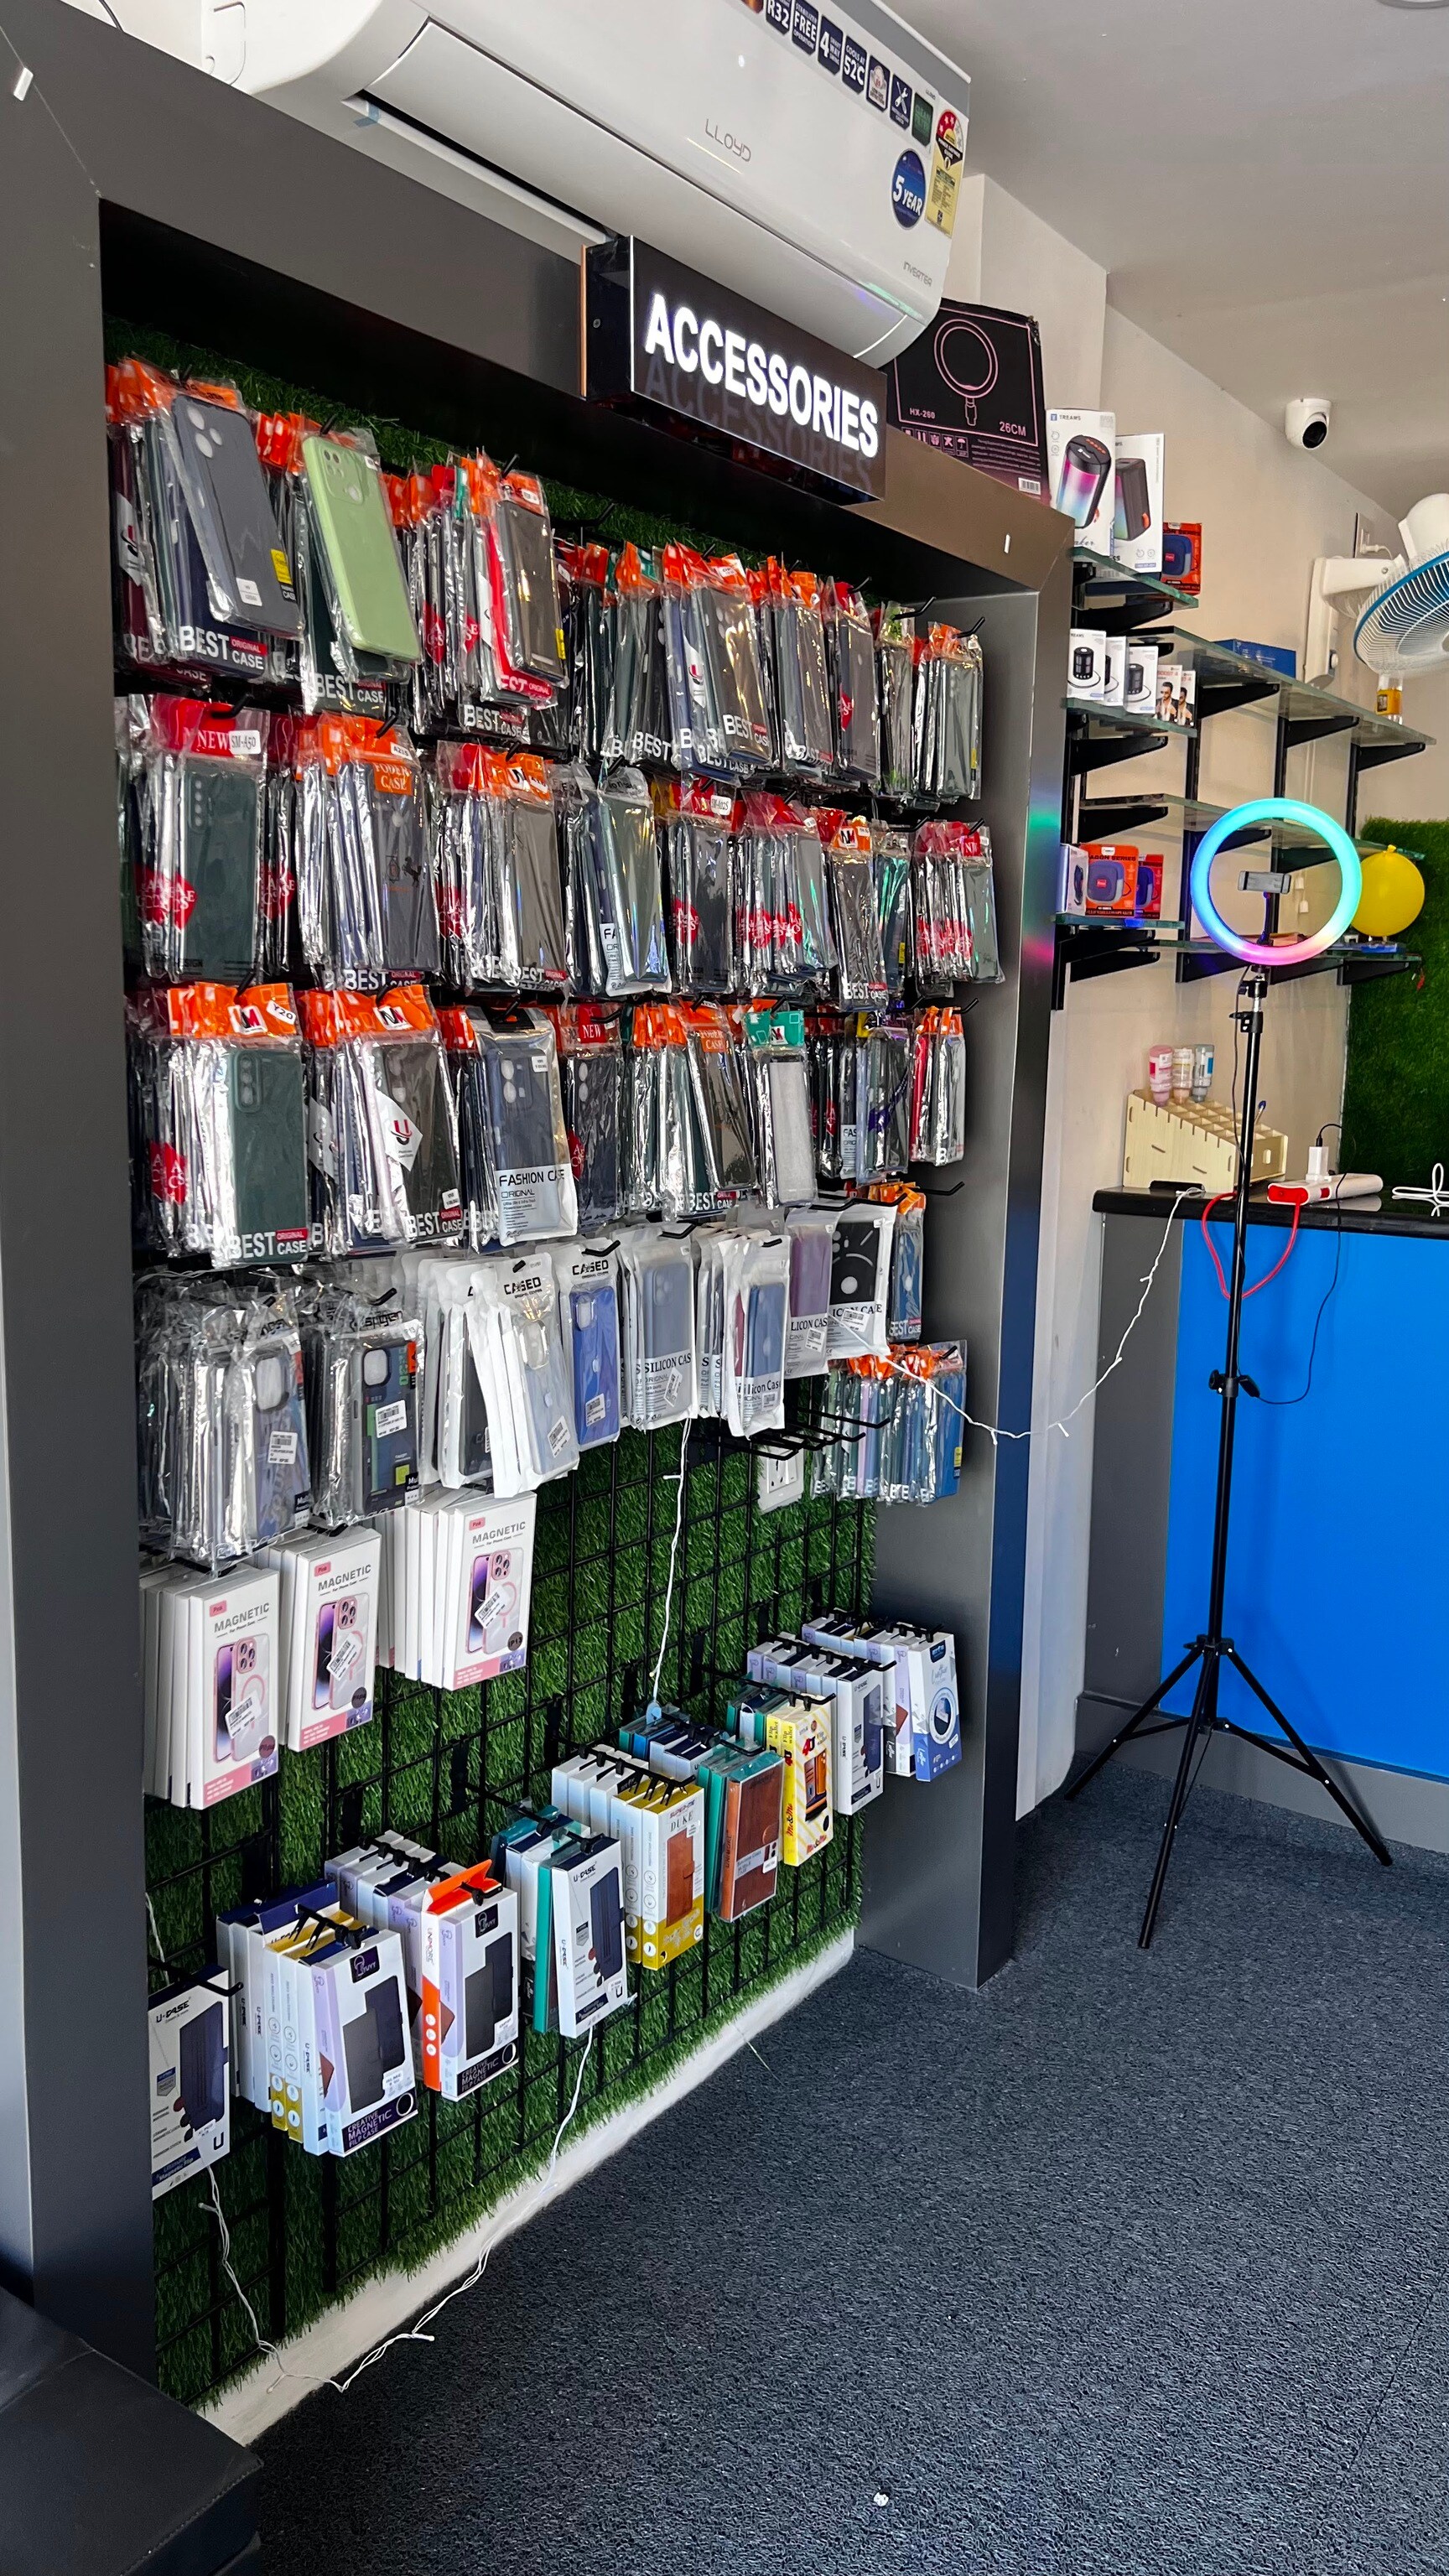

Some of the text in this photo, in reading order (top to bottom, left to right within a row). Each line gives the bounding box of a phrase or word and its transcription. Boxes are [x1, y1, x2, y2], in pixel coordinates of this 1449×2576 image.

[767, 0, 790, 29] R32
[794, 11, 818, 42] FREE
[819, 31, 830, 59] 4
[845, 44, 860, 61] COOLS
[704, 118, 751, 163] LLOYD
[892, 174, 923, 217] 5 YEAR
[902, 261, 933, 288] INVERTER
[644, 293, 879, 458] ACCESSORIES
[909, 408, 936, 419] HX-260
[999, 421, 1027, 438] 26CM
[179, 625, 262, 661] BEST ORIGINAL
[231, 650, 264, 670] CASE
[317, 673, 356, 701] BEST
[500, 674, 528, 693] EST
[357, 689, 385, 703] CASE
[464, 704, 501, 732] BEST
[723, 714, 753, 740] BEST
[197, 730, 231, 750] NEW
[501, 724, 522, 737] CASE
[633, 730, 672, 761] BEST
[729, 760, 750, 776] CASE
[380, 775, 408, 791] CASE
[342, 969, 387, 990] BEST
[846, 981, 869, 1000] BEST
[273, 1003, 293, 1020] Y20
[582, 1024, 601, 1038] NEW
[499, 1171, 544, 1187] FASHION
[688, 1192, 717, 1211] BEST
[403, 1211, 441, 1239] BEST
[440, 1209, 461, 1219] ORIGINAL
[442, 1219, 462, 1233] CASE
[230, 1231, 276, 1259] BEST
[277, 1232, 305, 1240] ORIGINAL
[277, 1242, 307, 1256] CASE
[572, 1259, 610, 1276] CASED
[503, 1276, 542, 1296] CASED
[860, 1304, 882, 1315] CAE
[365, 1311, 402, 1330] spigen
[791, 1317, 828, 1332] LICON CAS
[644, 1353, 692, 1374] SILICON CAS
[472, 1521, 527, 1545] MAGNETIC
[317, 1564, 371, 1592] MAGNETIC
[214, 1602, 270, 1633] MAGNETIC
[507, 1635, 523, 1648] IP13
[670, 1811, 694, 1832] DUKE
[461, 2059, 488, 2079] CREATIVE
[461, 2057, 499, 2085] MAGNETIC
[474, 2073, 488, 2085] CASE
[347, 2111, 378, 2133] CREATIVE
[347, 2109, 392, 2142] MAGNETIC
[213, 2131, 225, 2151] U
[363, 2126, 379, 2140] CASE
